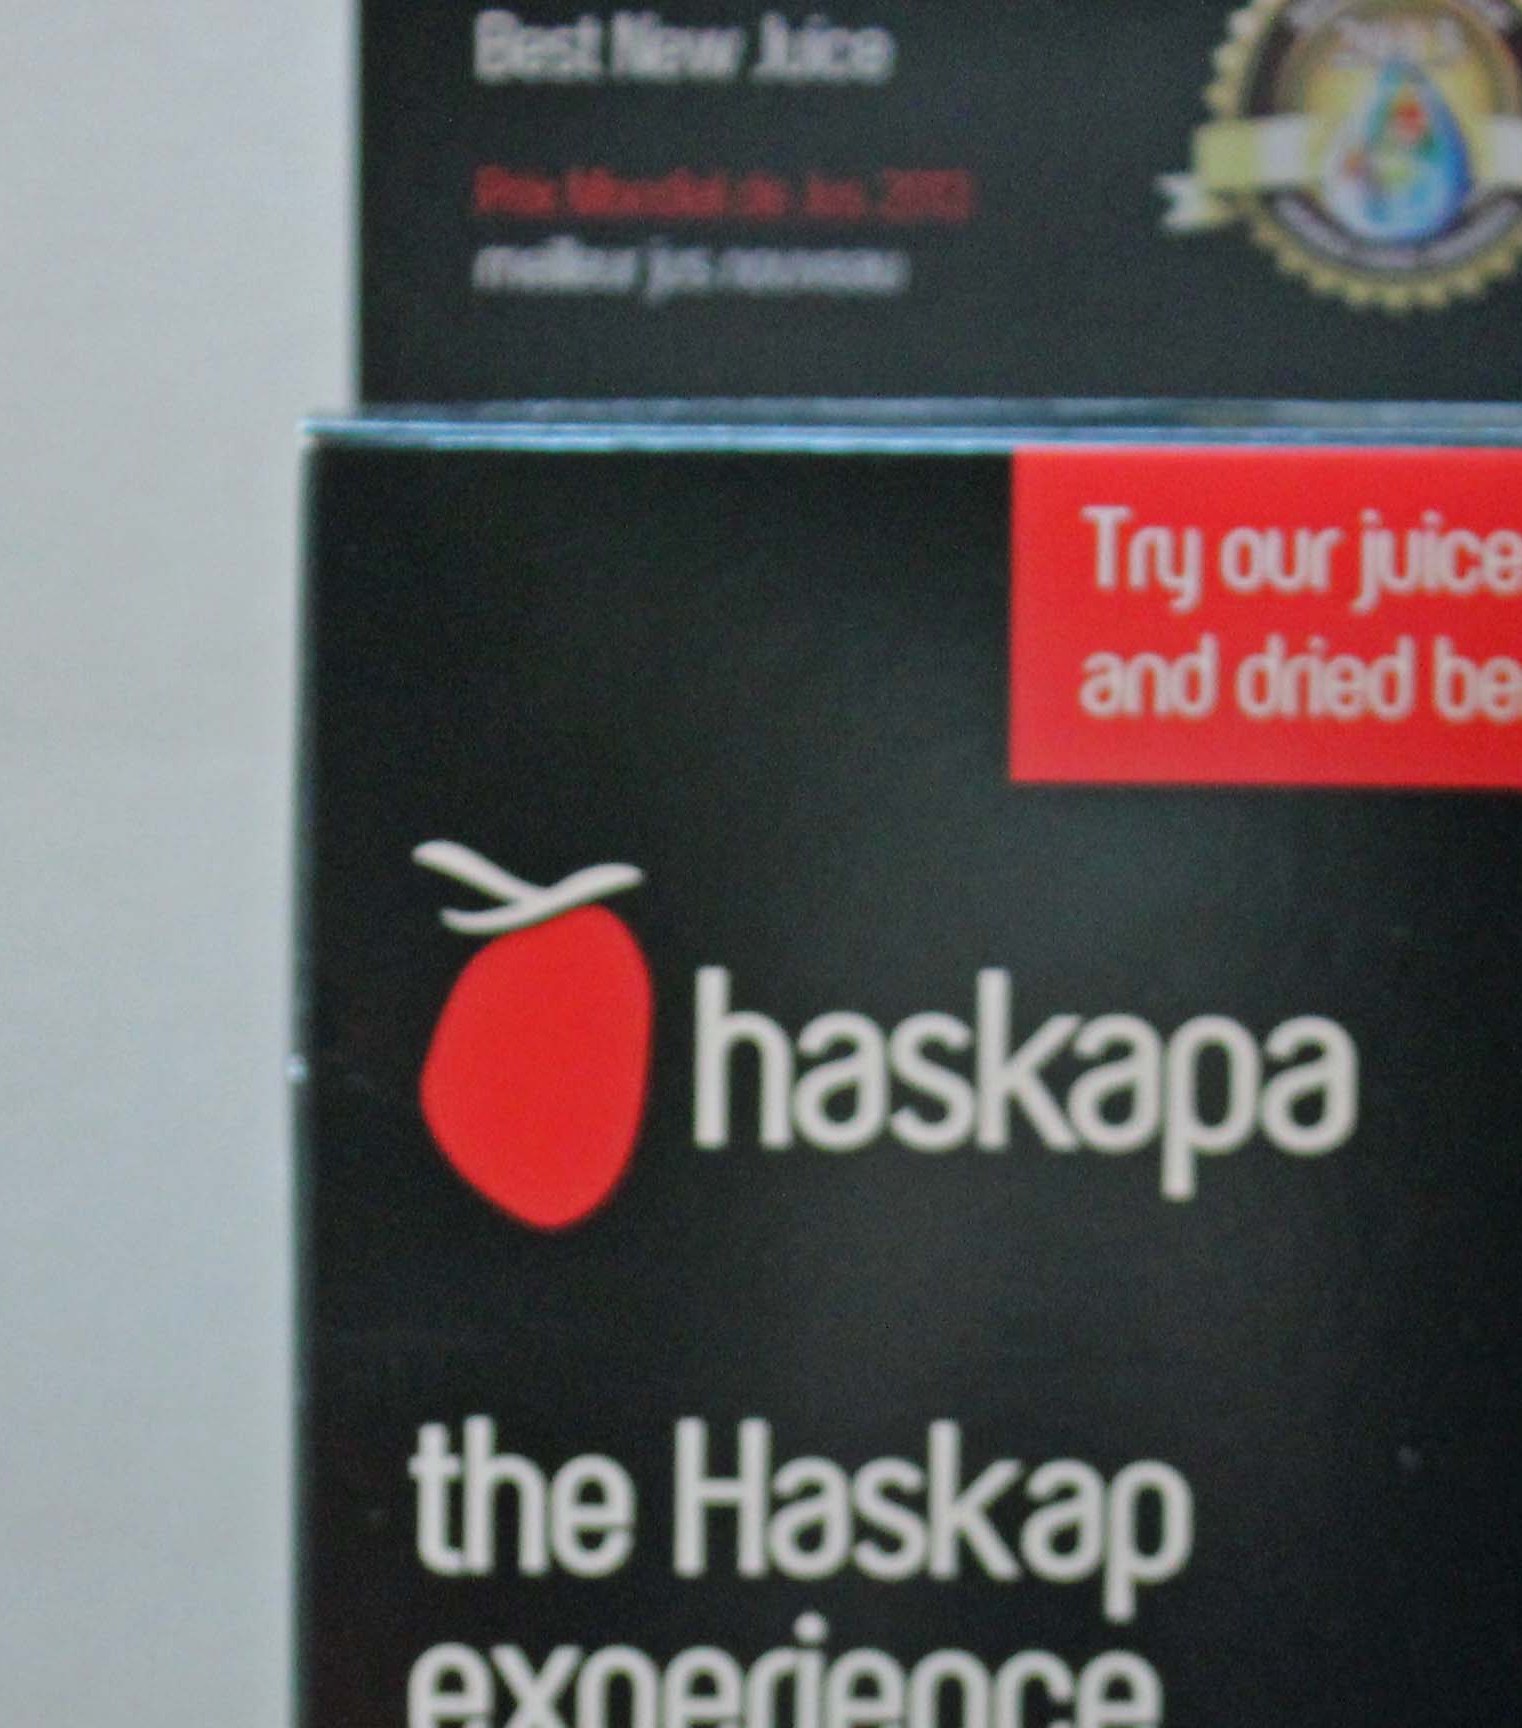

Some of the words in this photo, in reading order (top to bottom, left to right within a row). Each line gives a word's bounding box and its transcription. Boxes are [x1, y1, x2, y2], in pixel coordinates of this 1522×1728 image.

[1081, 504, 1203, 615] Try
[1219, 526, 1341, 592] our
[1079, 632, 1217, 718] and
[1235, 633, 1415, 719] dried
[693, 965, 1361, 1200] haskapa
[408, 1414, 637, 1578] the
[674, 1416, 1195, 1622] Haskap
